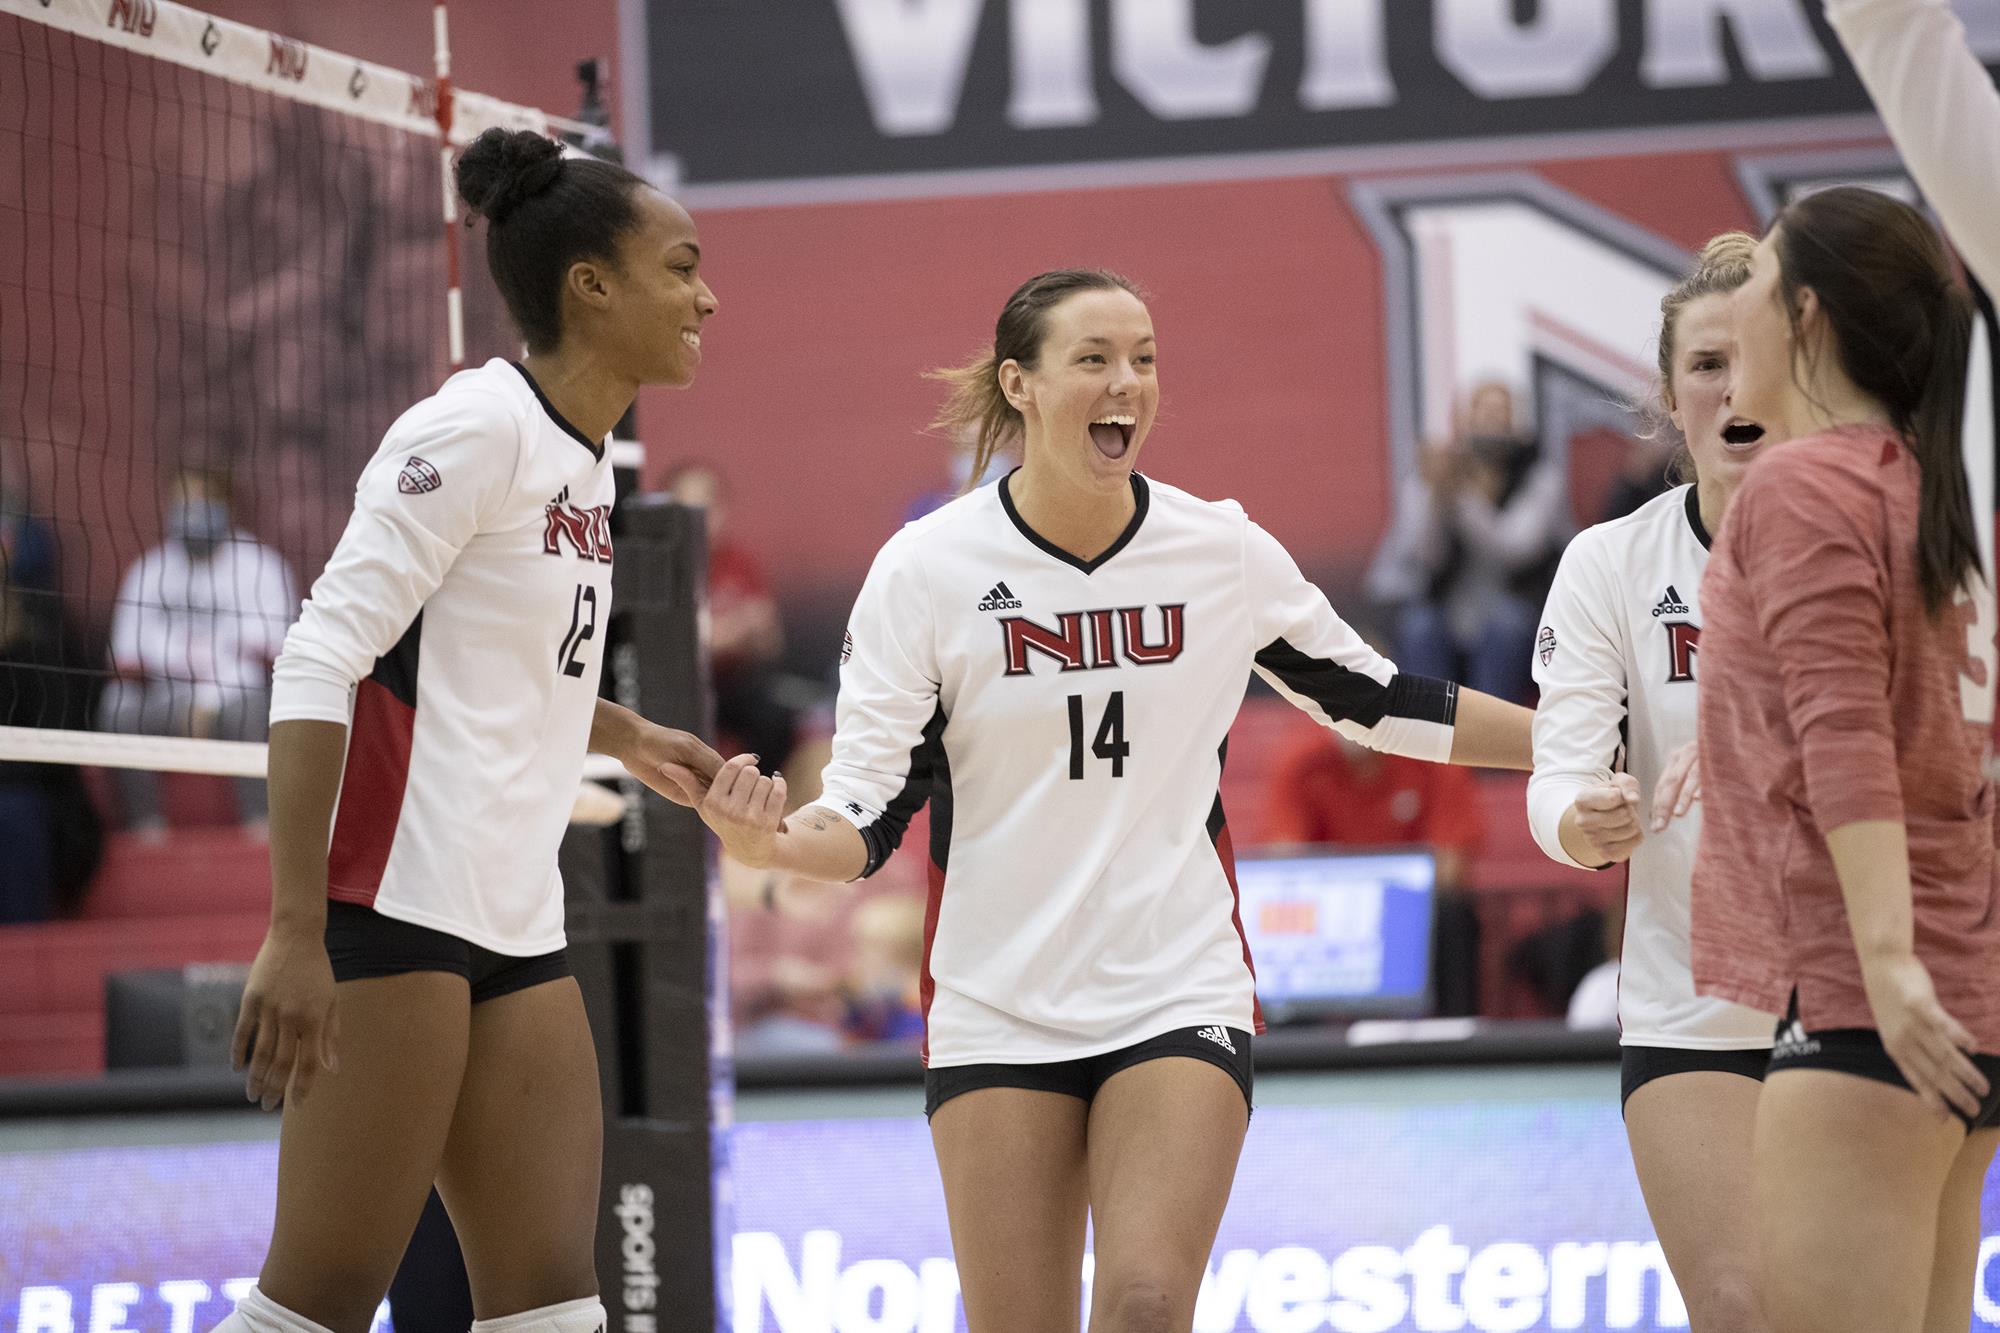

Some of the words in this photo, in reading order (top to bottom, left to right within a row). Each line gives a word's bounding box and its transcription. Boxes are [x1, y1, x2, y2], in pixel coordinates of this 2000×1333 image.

[541, 504, 613, 564] NIU
[557, 584, 596, 678] 12
[978, 599, 1022, 611] adidas
[1652, 603, 1689, 617] aidas
[996, 602, 1187, 677] NIU
[1067, 691, 1130, 780] 14
[1197, 1030, 1236, 1055] adidas
[731, 1226, 1692, 1333] Norestern
